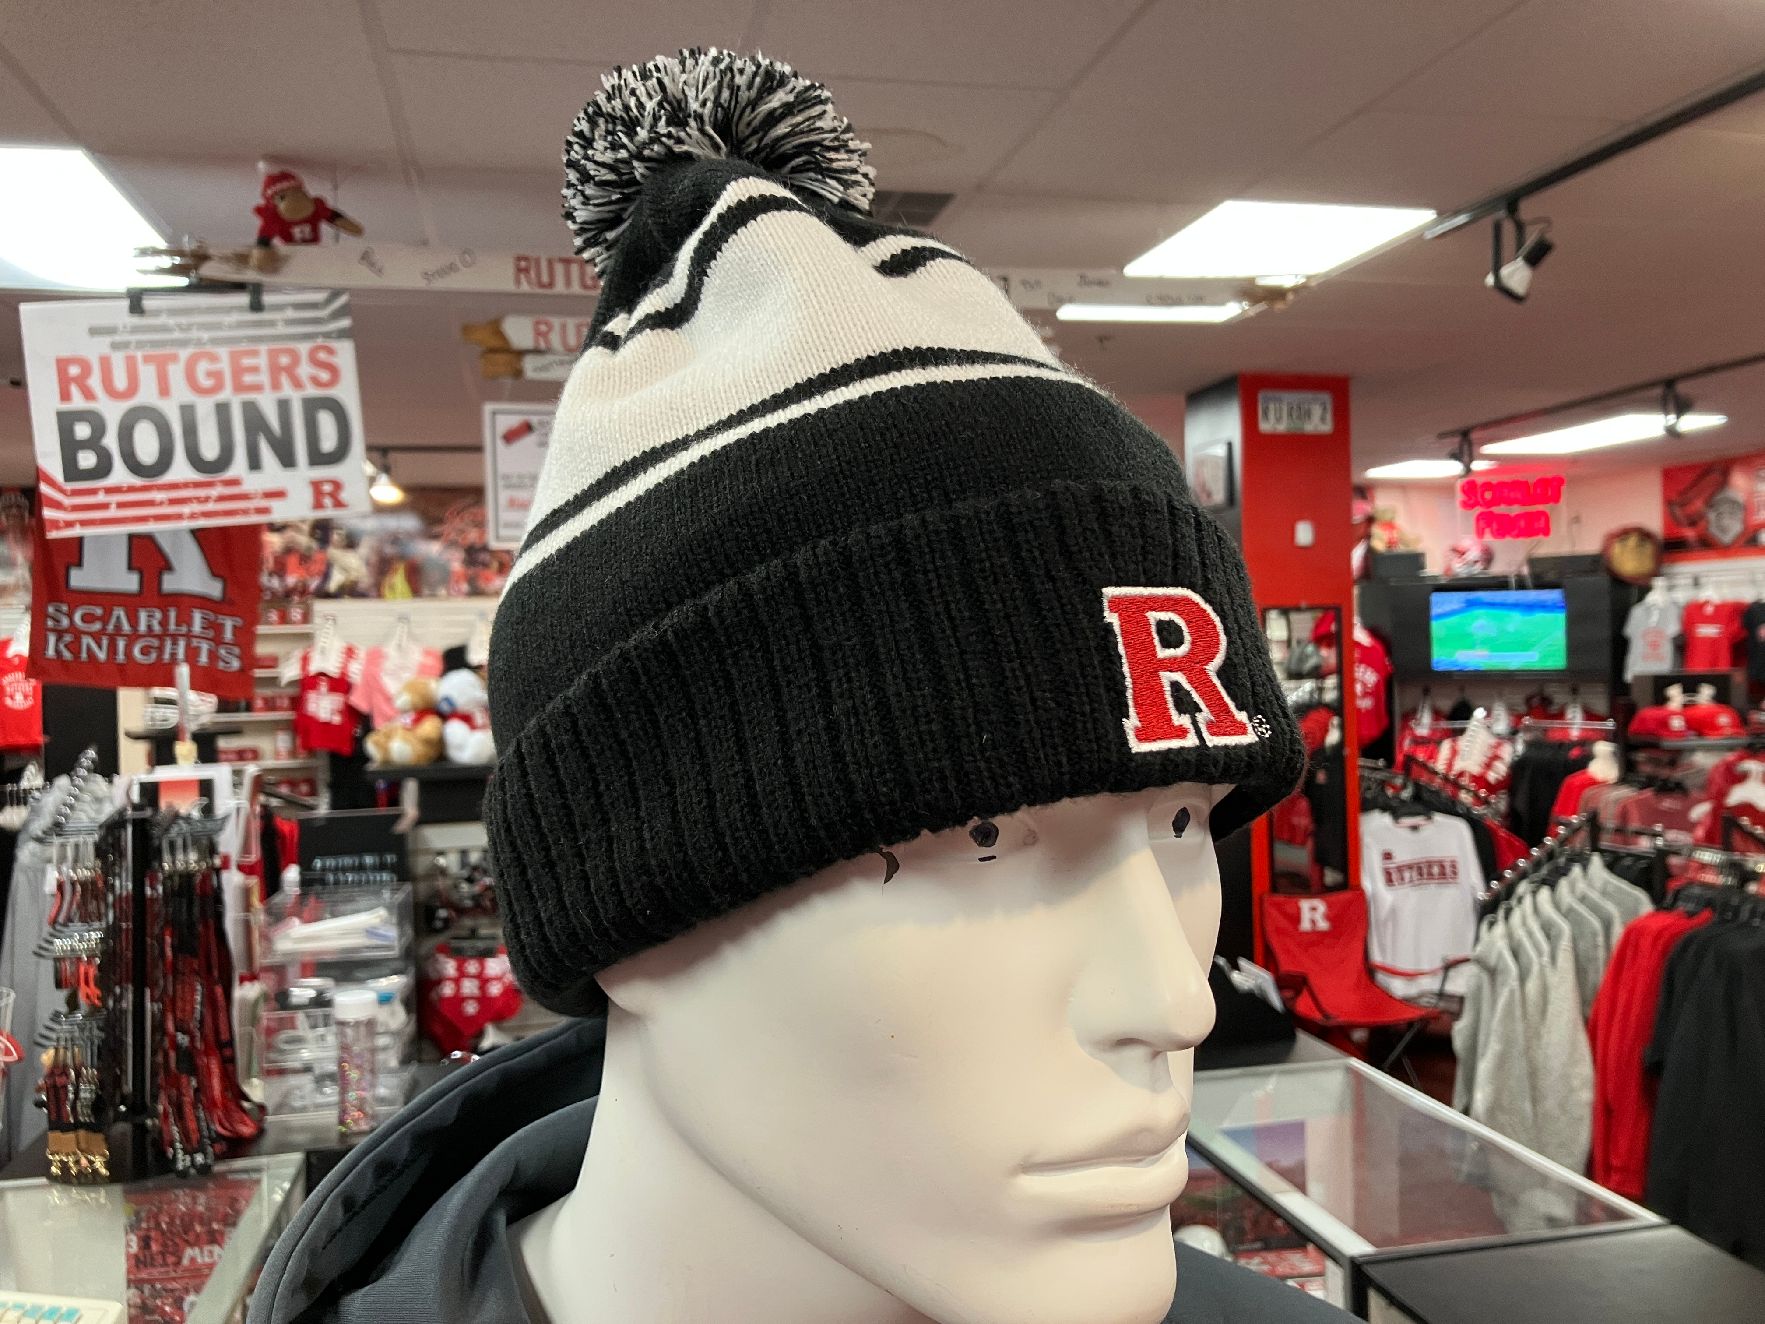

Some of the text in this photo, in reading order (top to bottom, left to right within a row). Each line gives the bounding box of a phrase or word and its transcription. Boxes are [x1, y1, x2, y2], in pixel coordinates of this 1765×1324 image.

[513, 254, 600, 291] RUTG
[55, 343, 342, 405] RUTGERS
[56, 396, 352, 483] BOUND
[309, 479, 348, 511] R
[46, 602, 244, 643] SCARLET
[44, 631, 242, 672] KNIGHTS
[1102, 586, 1259, 753] R
[1297, 898, 1332, 933] R
